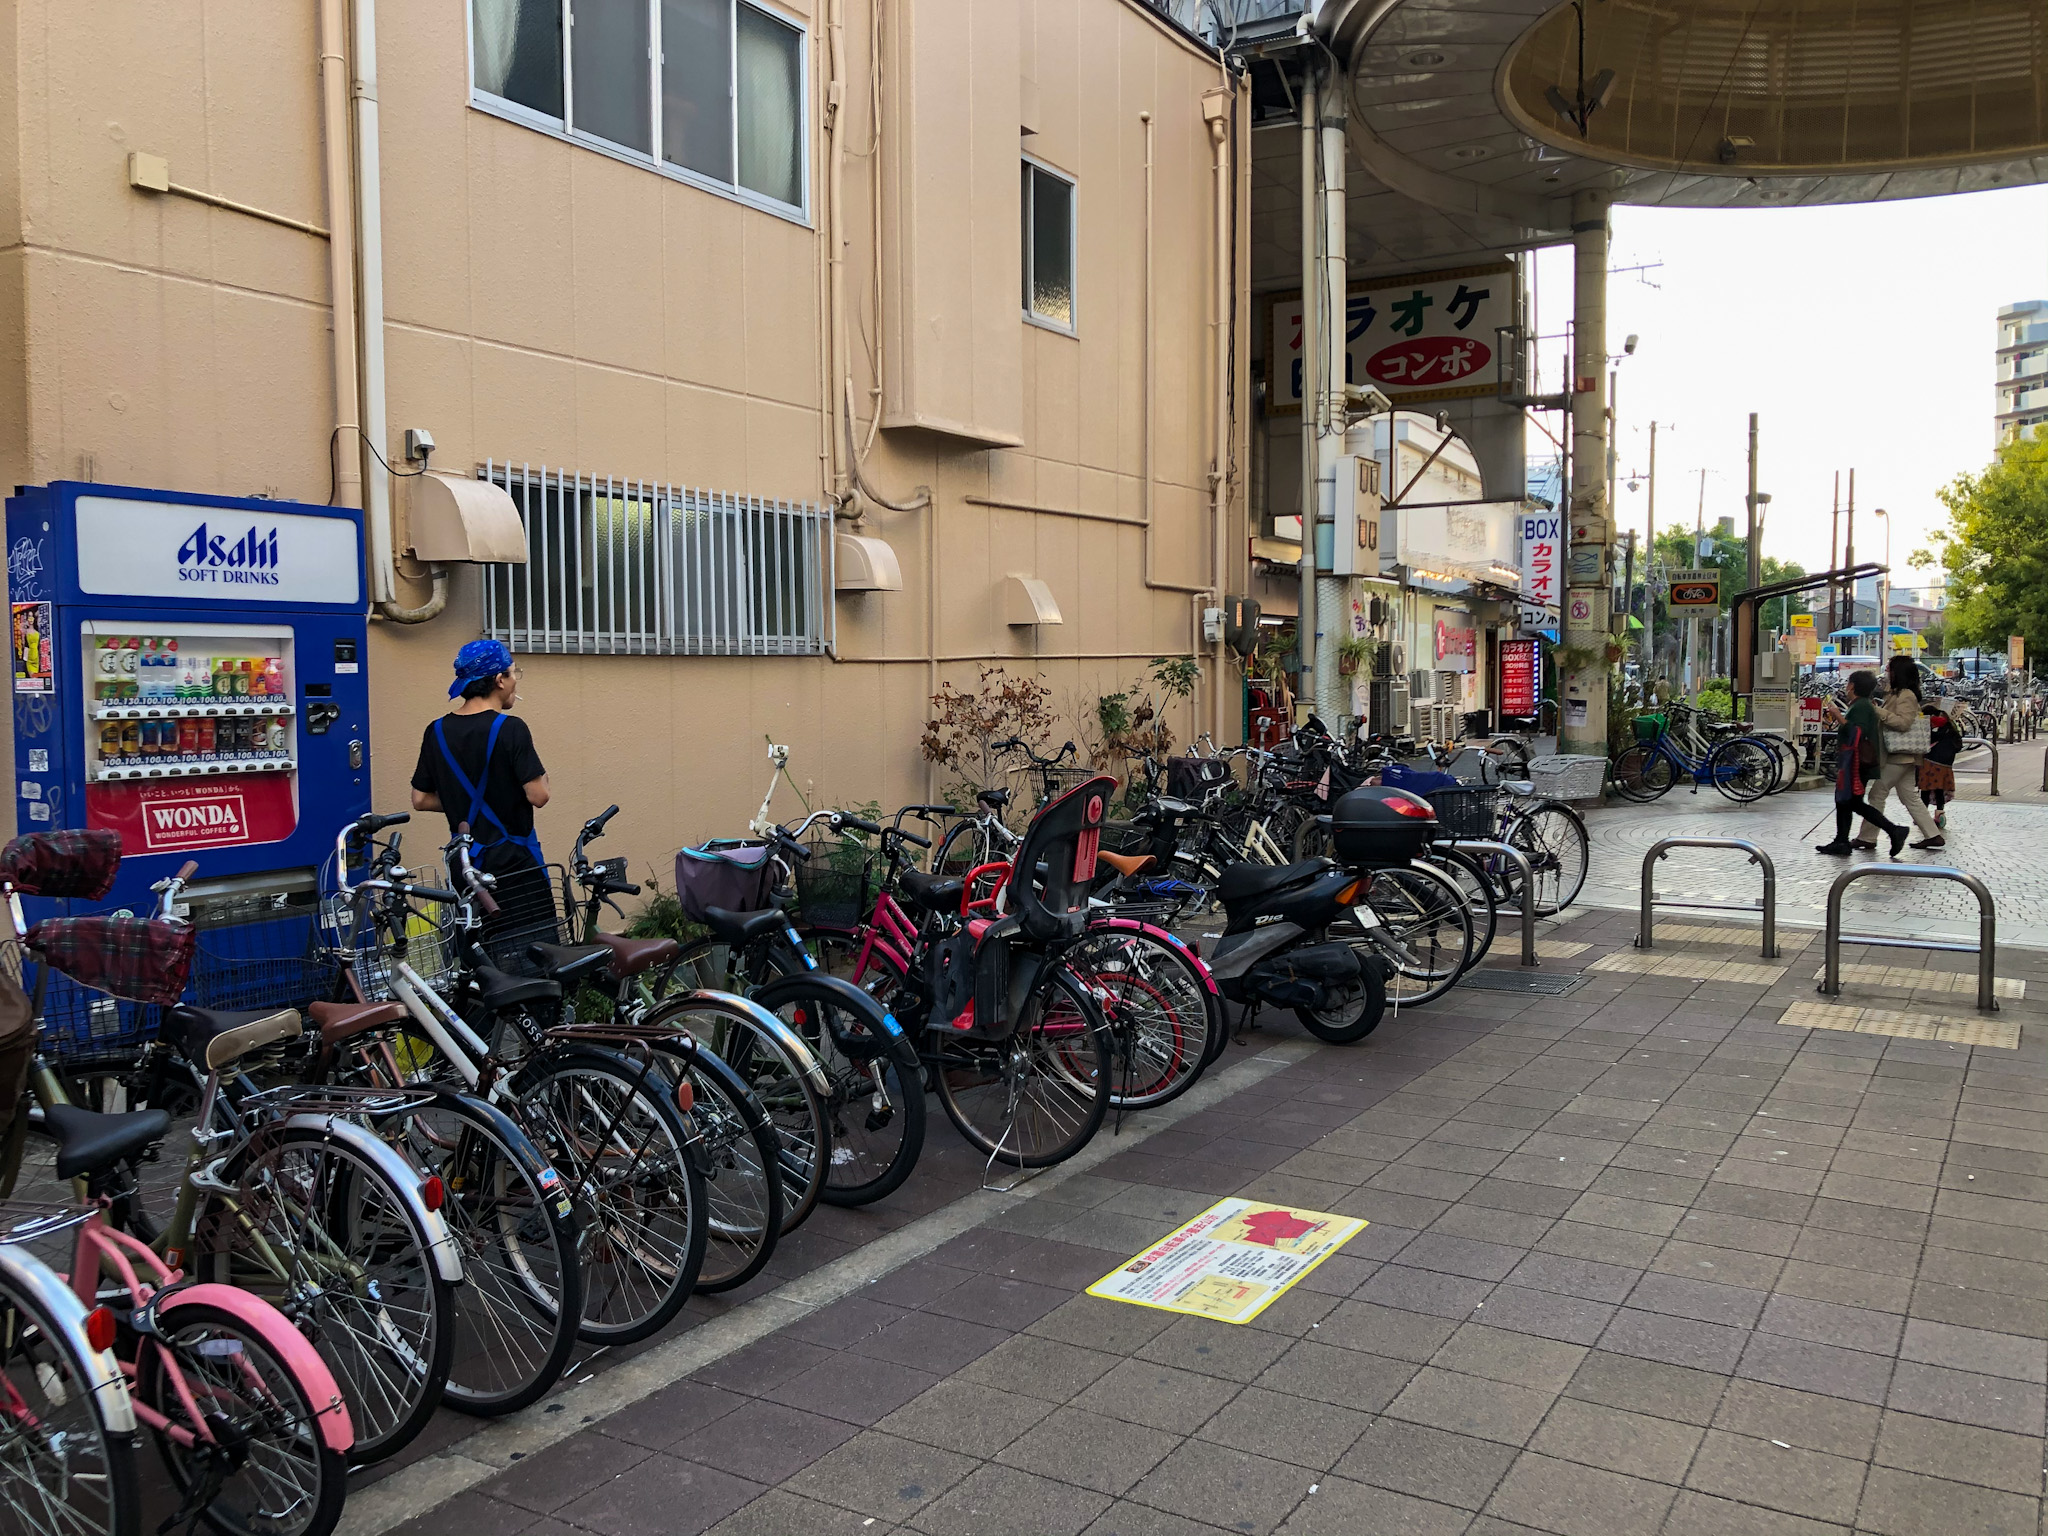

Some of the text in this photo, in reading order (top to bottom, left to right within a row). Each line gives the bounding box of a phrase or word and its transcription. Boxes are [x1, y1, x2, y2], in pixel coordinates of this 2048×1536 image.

[1381, 340, 1476, 380] コンポ
[1525, 518, 1559, 540] BOX
[177, 521, 278, 569] Asahi
[178, 567, 279, 585] SOFT DRINKS
[1502, 643, 1532, 653] カラオケ
[152, 804, 238, 829] WONDA
[155, 826, 227, 839] WONDERFUL COFFEE
